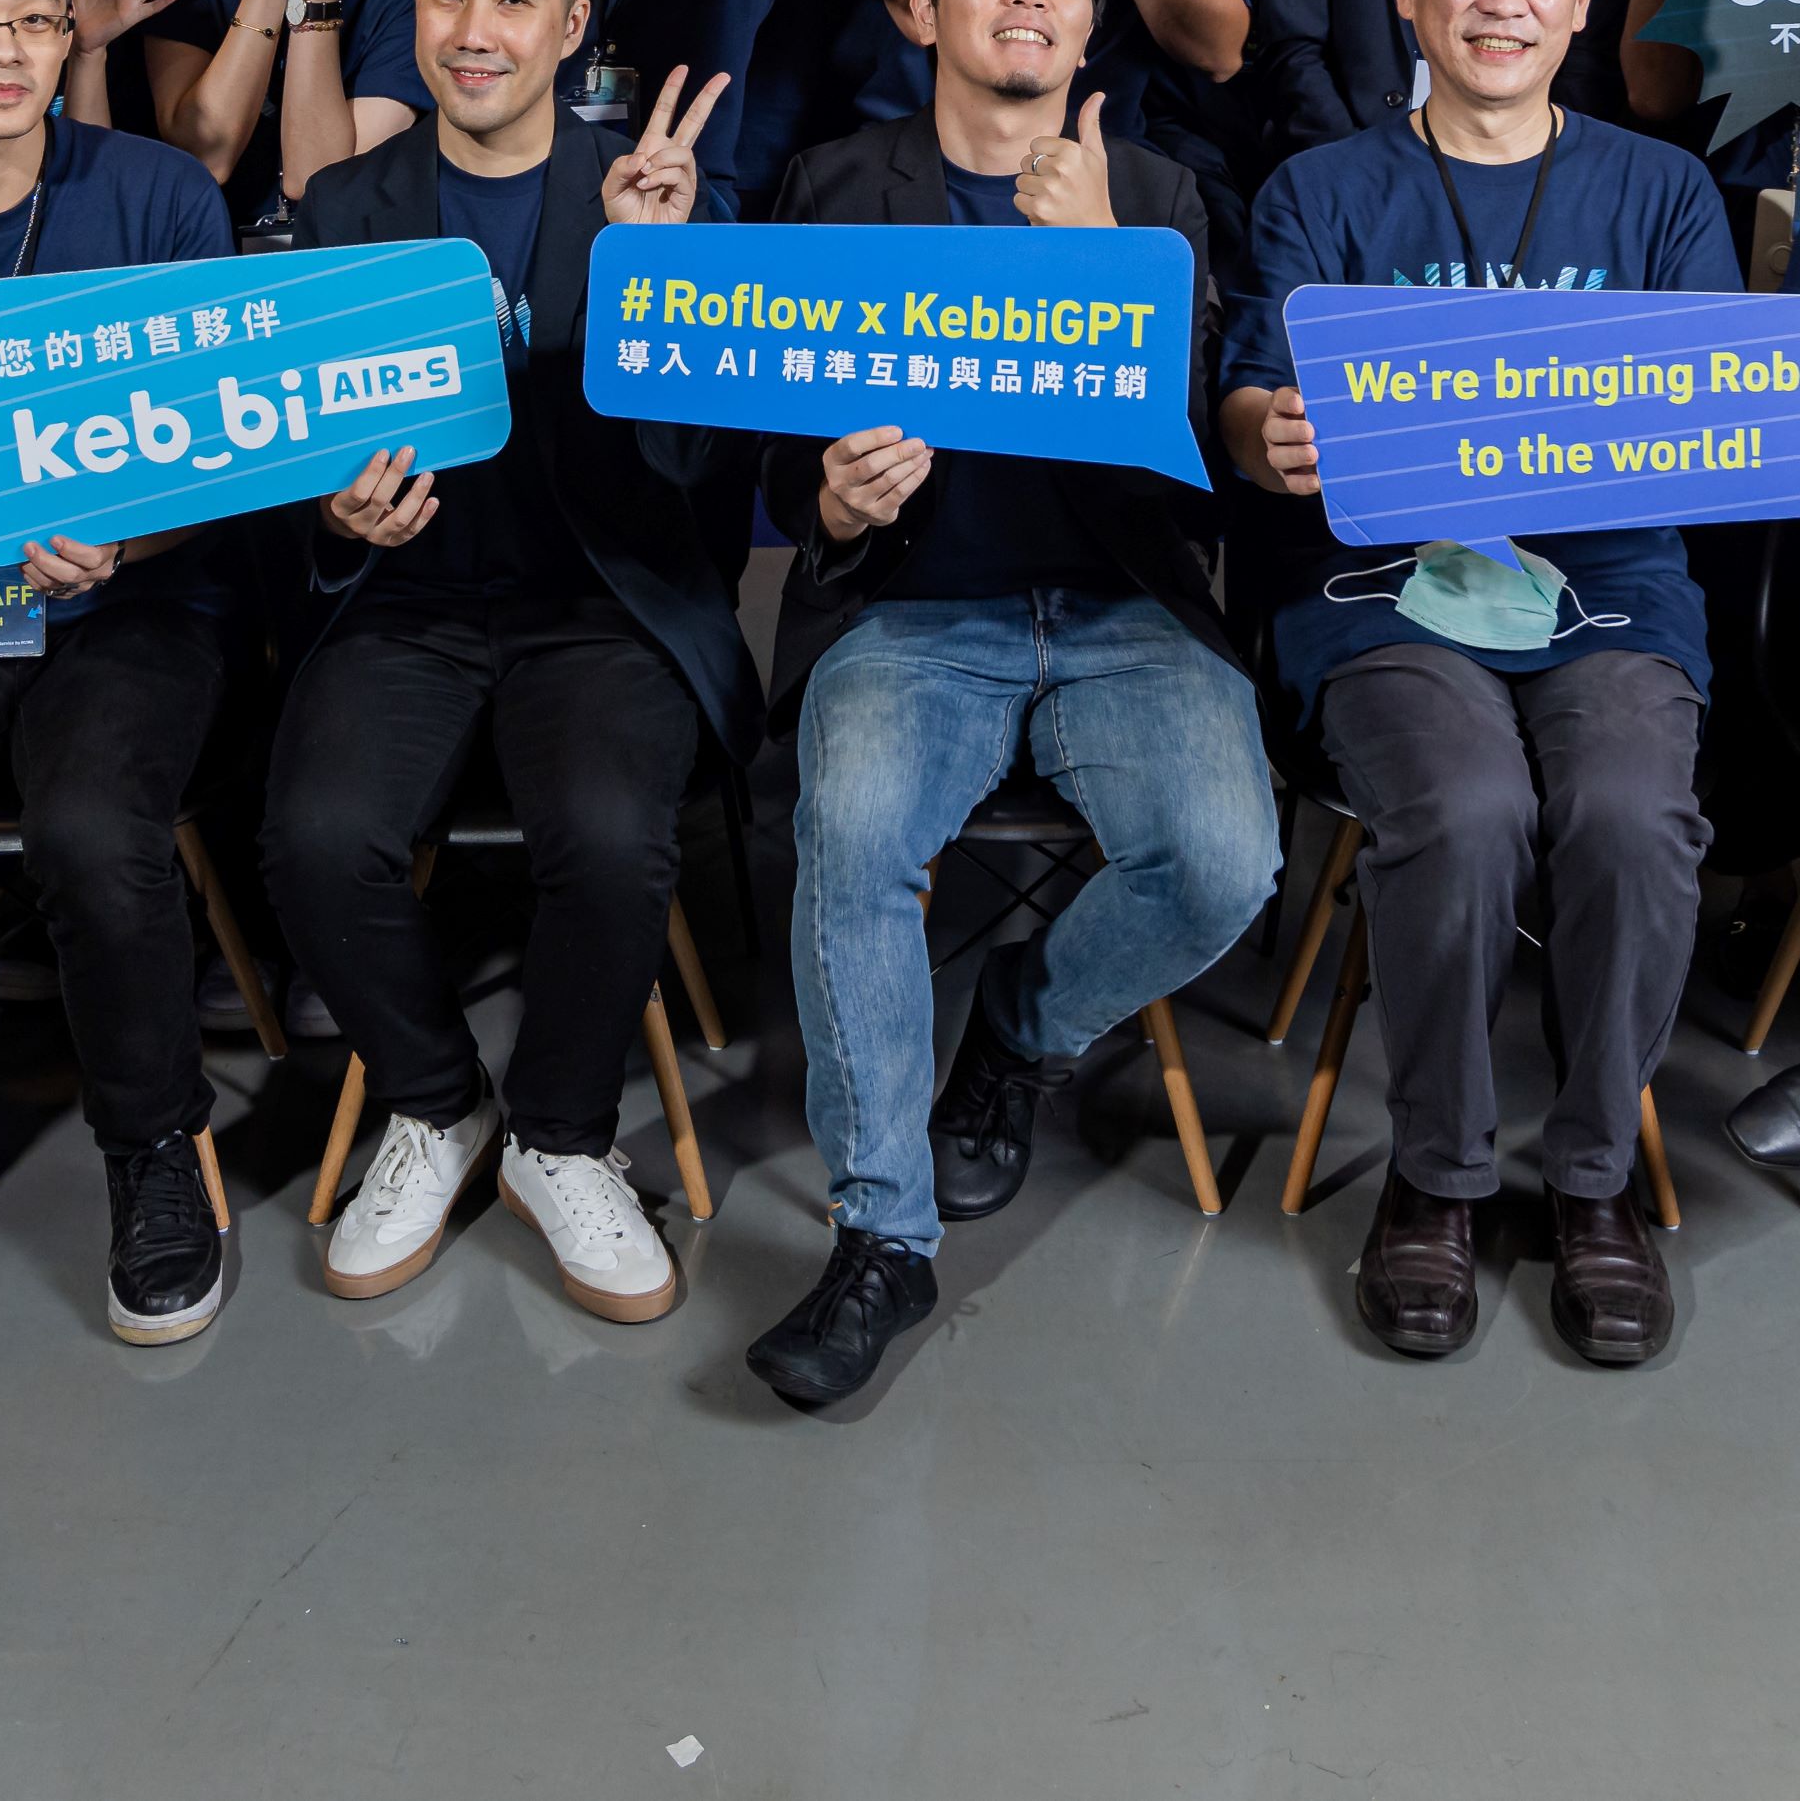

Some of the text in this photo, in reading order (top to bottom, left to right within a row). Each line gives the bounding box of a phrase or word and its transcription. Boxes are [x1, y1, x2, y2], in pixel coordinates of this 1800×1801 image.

[858, 302, 887, 335] x
[904, 292, 1155, 349] KebbiGPT
[331, 356, 451, 405] AIR-S
[617, 340, 1148, 401] 導入 AI 精準互動與品牌行銷
[1344, 359, 1480, 404] We're
[1495, 354, 1695, 407] bringing
[1458, 428, 1763, 478] to the world!
